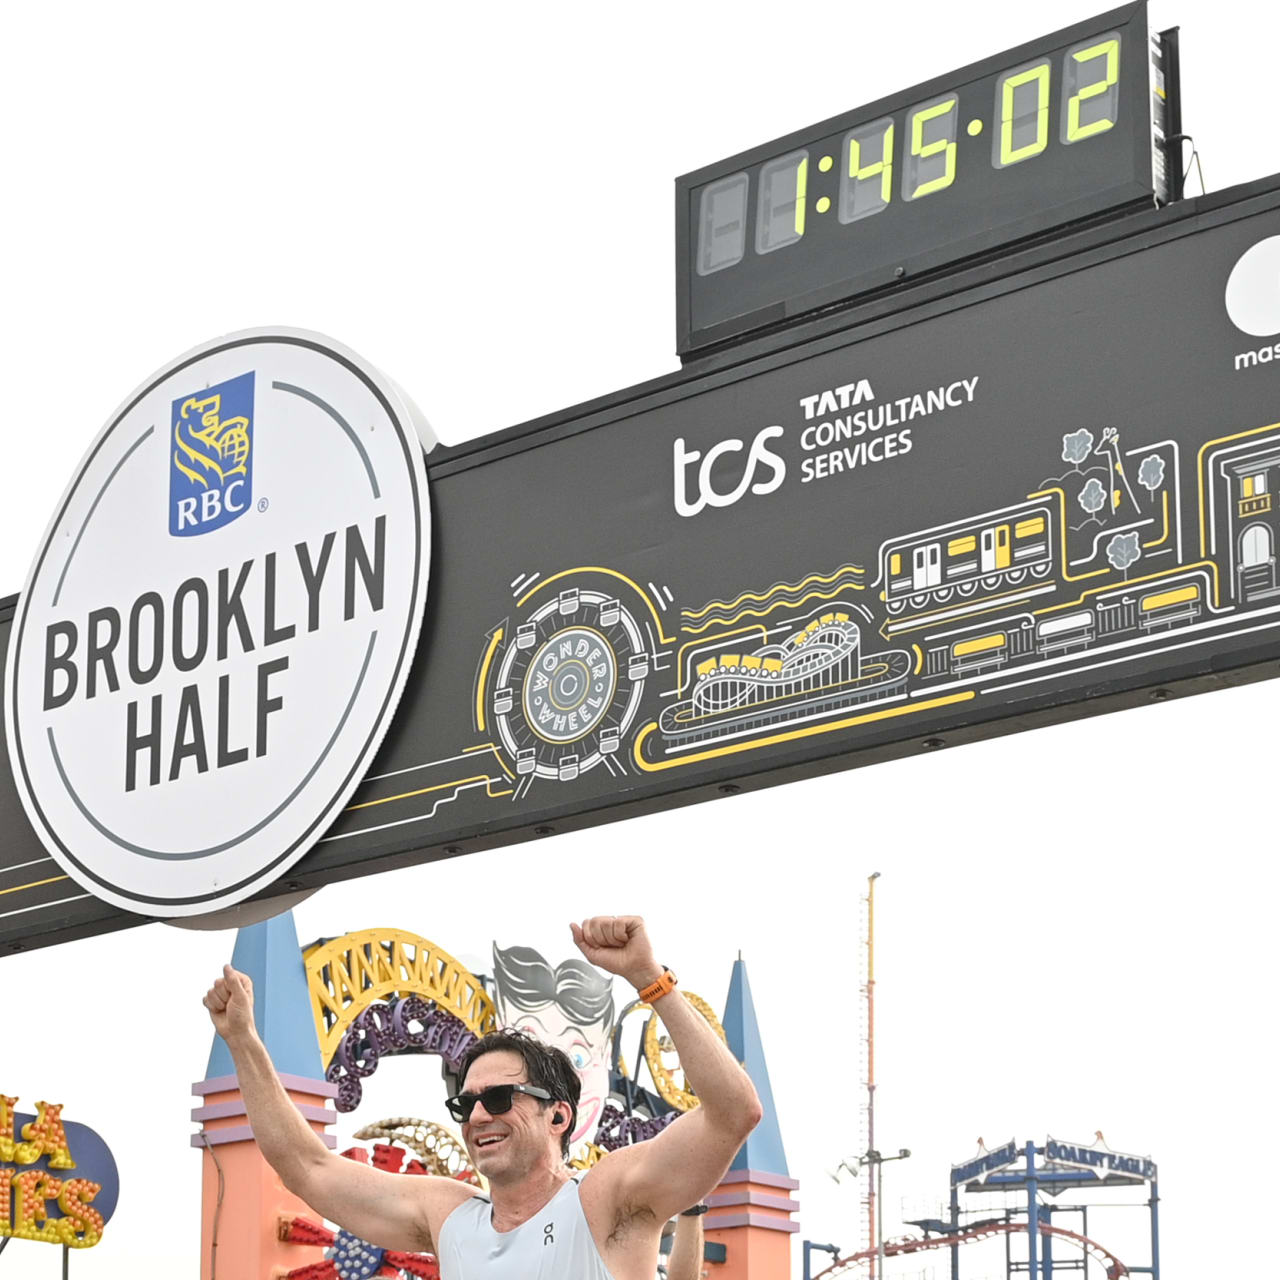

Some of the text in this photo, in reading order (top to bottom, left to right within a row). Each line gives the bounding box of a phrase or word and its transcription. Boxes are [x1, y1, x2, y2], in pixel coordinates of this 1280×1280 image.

[800, 379, 875, 419] TATA
[800, 376, 979, 451] CONSULTANCY
[674, 425, 786, 517] tcs
[801, 429, 913, 483] SERVICES
[176, 480, 245, 531] RBC
[43, 514, 387, 711] BROOKLYN
[532, 638, 606, 692] WONDER
[125, 656, 290, 792] HALF
[537, 696, 603, 731] WHEEL
